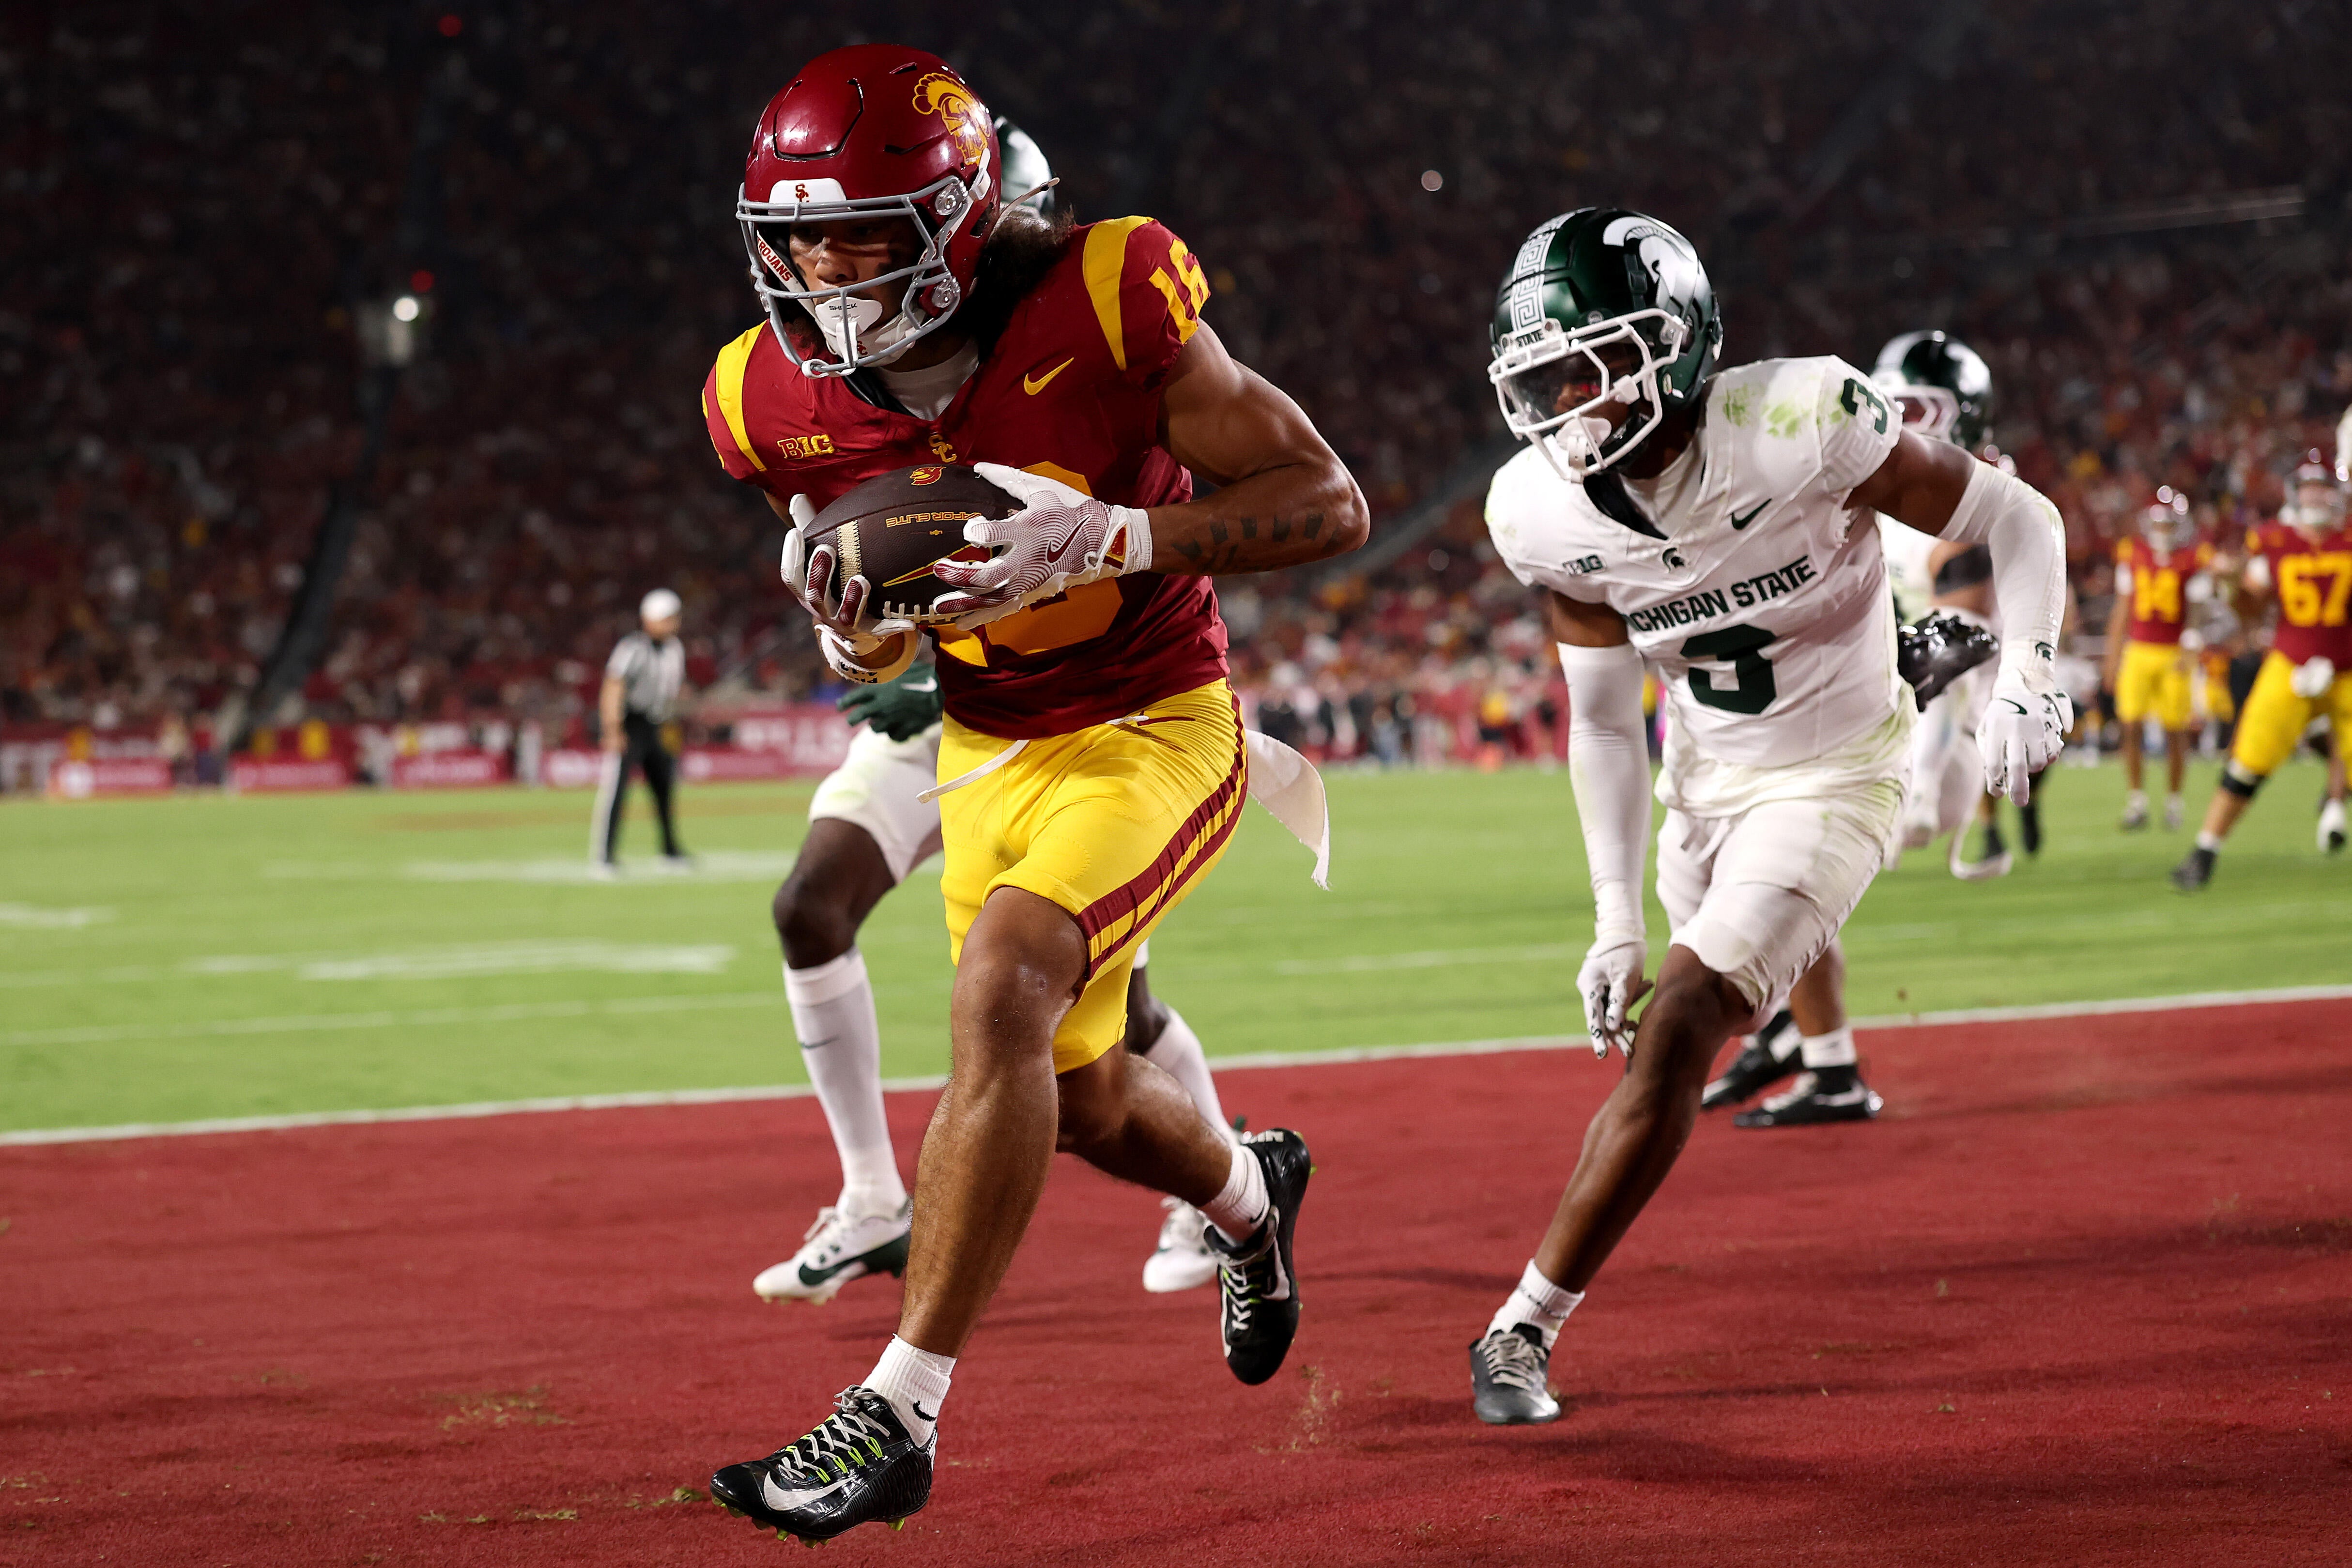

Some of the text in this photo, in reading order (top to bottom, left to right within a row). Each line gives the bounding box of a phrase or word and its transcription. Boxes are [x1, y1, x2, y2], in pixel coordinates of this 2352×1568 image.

[1841, 378, 1887, 434] 3
[928, 434, 957, 462] SC
[885, 512, 931, 528] ELITE
[1731, 554, 1817, 607] STATE
[1679, 624, 1777, 715] 3
